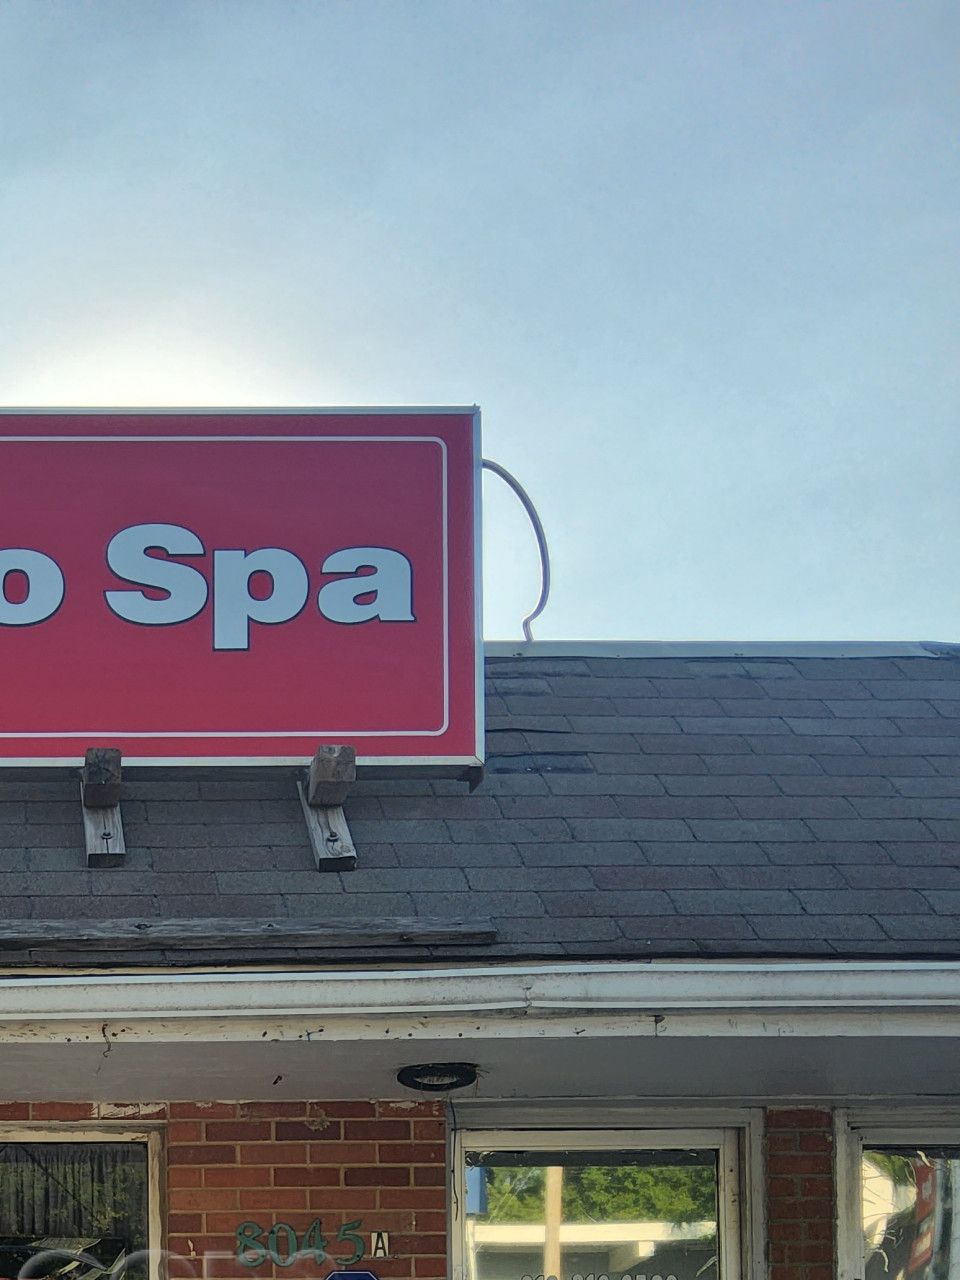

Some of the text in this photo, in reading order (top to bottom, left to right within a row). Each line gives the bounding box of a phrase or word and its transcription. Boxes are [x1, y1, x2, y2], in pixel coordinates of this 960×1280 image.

[104, 522, 416, 652] Spa
[235, 1218, 389, 1268] 8045 A
